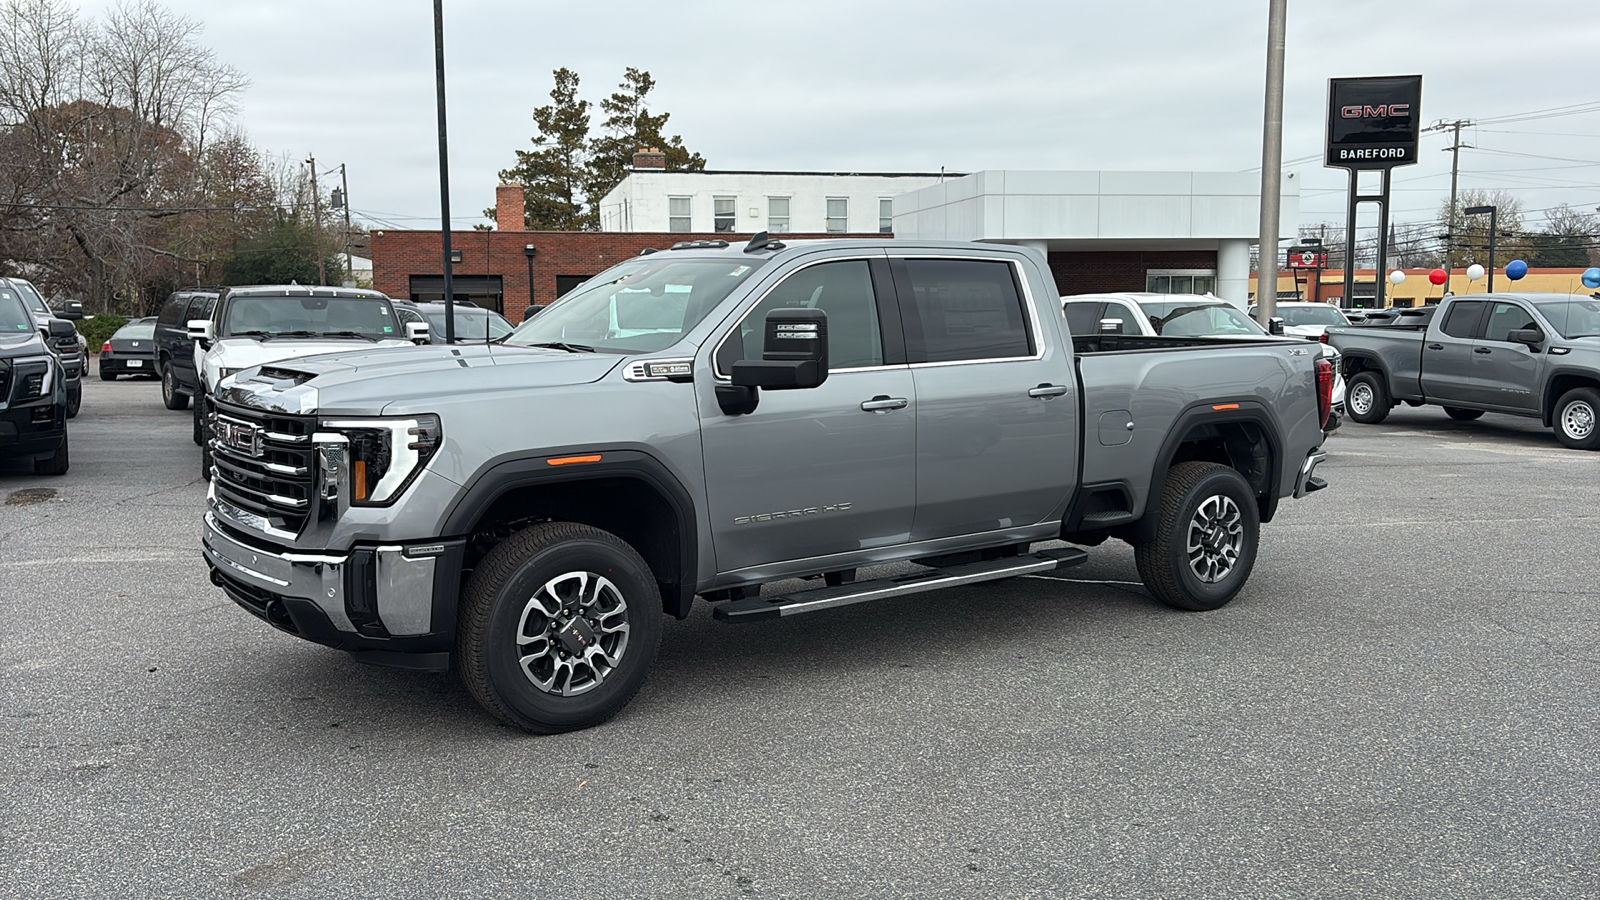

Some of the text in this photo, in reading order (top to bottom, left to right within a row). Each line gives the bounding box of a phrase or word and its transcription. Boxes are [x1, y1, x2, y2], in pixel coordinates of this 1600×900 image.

[1341, 104, 1410, 118] GMC
[1340, 148, 1405, 159] BAREFORD
[734, 502, 852, 525] SIERRA HD
